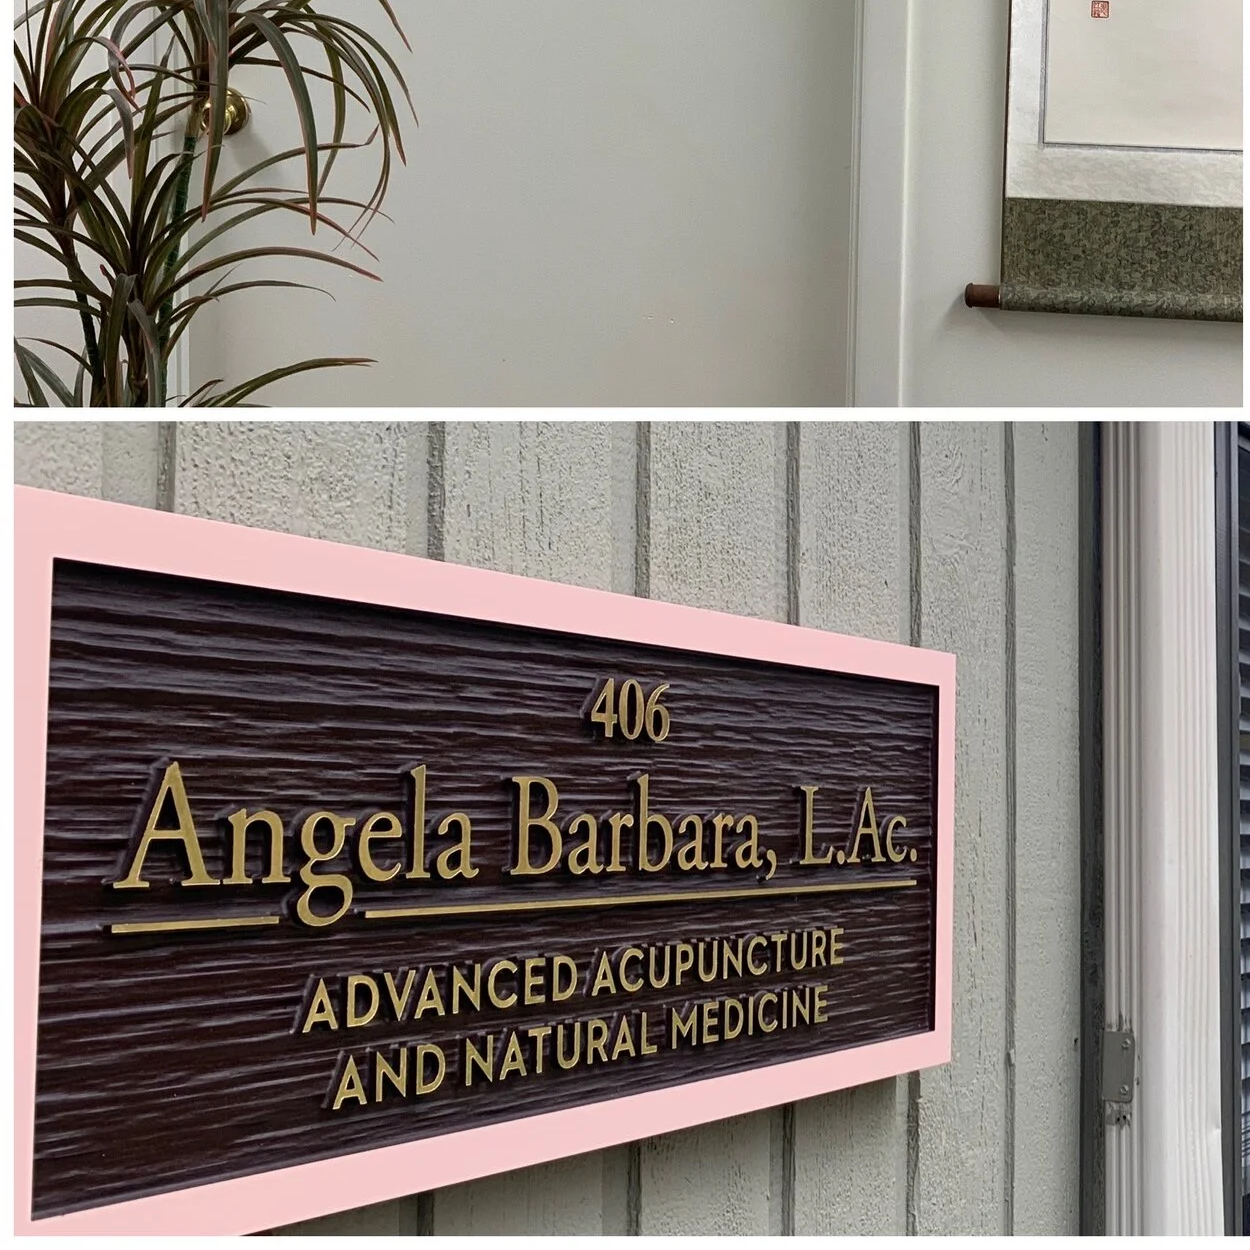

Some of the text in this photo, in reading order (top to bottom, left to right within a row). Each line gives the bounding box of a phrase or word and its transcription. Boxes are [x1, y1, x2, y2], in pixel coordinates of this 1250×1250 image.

[590, 677, 671, 743] 406
[113, 761, 918, 928] Angela Barbara, L.Ac.
[302, 927, 845, 1034] ADVANCED ACUPUNCTURE
[332, 984, 830, 1110] AND NATURAL MEDICINE
